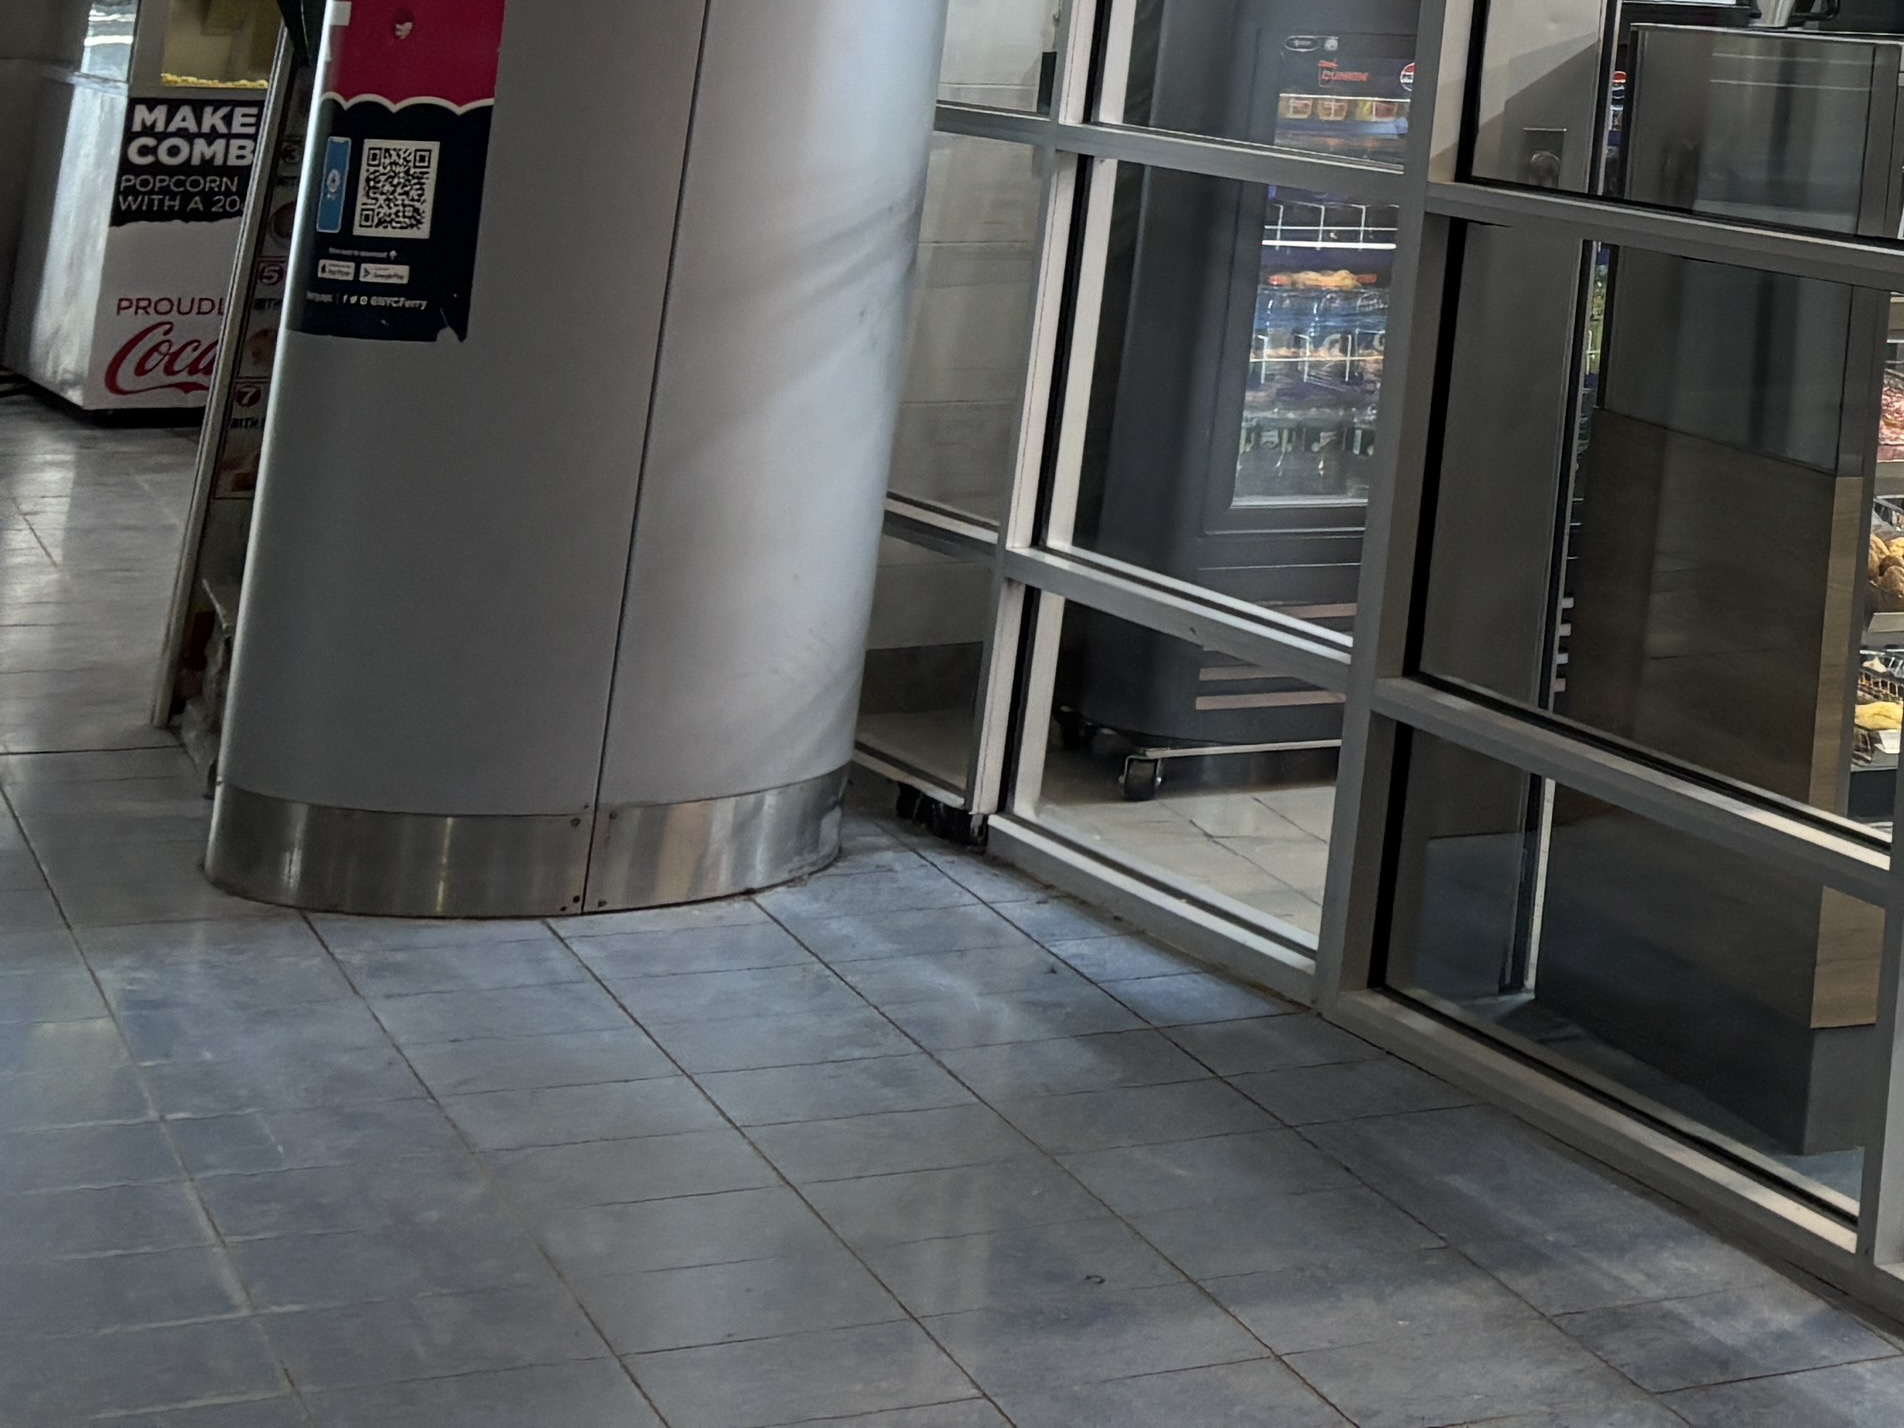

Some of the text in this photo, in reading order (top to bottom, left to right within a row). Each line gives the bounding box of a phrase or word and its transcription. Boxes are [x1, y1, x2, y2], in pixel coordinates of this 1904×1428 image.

[131, 104, 259, 134] MAKE
[127, 136, 254, 167] COMB
[120, 175, 238, 193] POPCORN
[119, 195, 244, 213] WITH A 20
[262, 265, 281, 285] 5
[239, 387, 257, 406] 7
